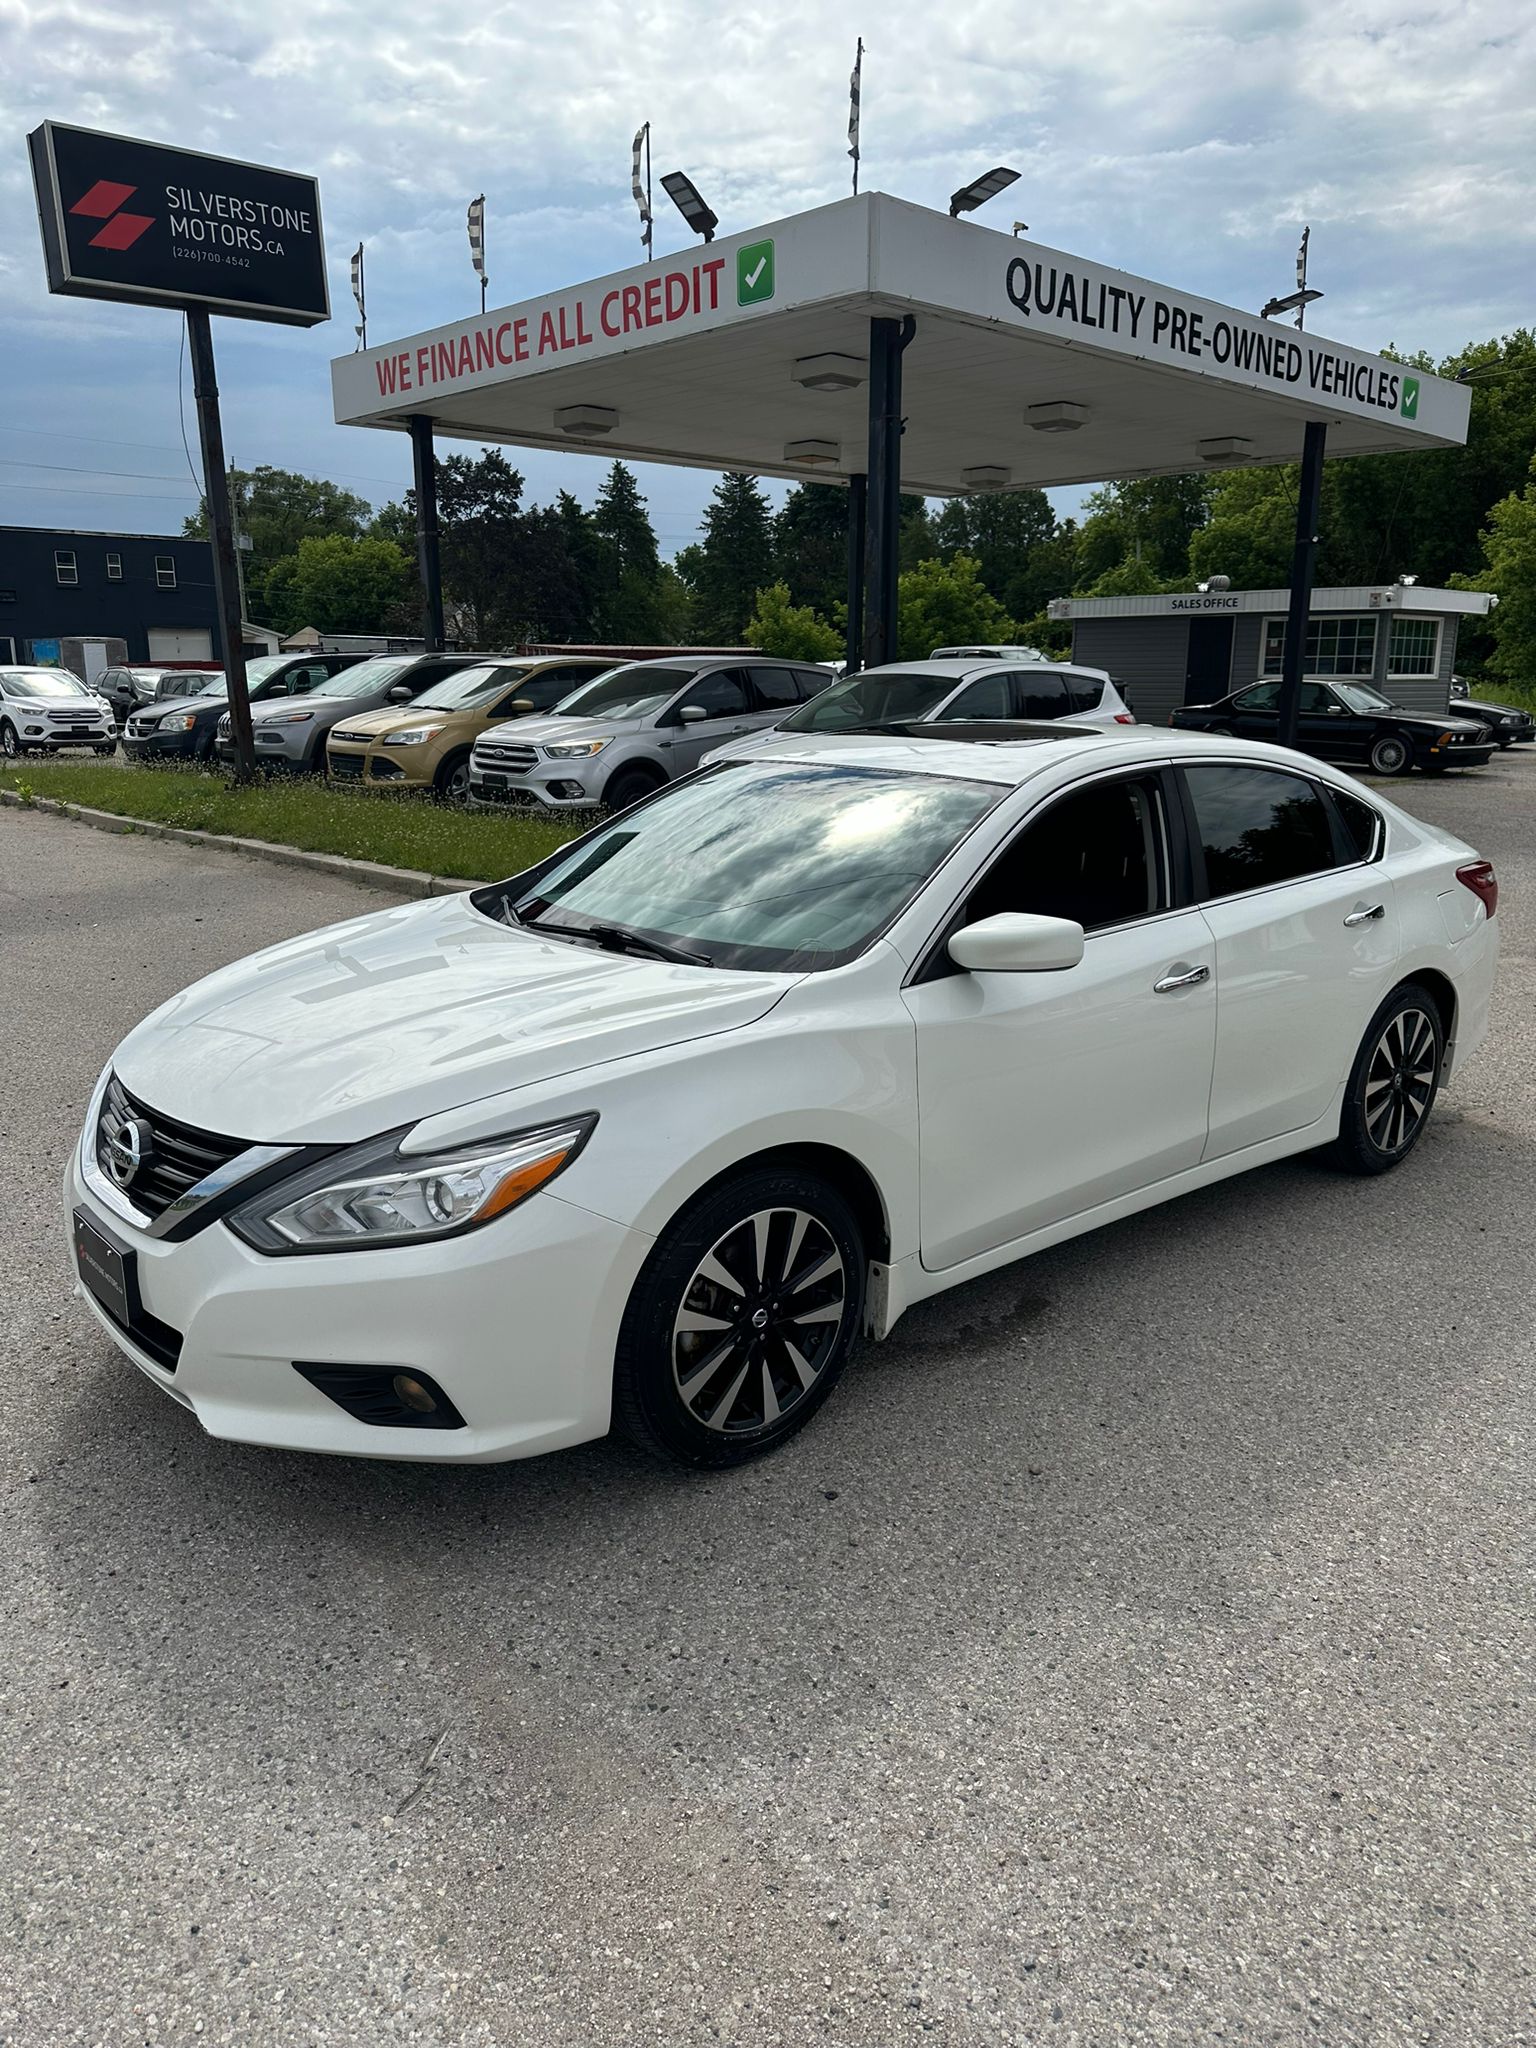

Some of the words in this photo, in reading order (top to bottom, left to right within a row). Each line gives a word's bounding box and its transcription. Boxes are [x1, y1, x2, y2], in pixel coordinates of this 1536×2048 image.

[166, 186, 312, 233] SILVERSTONE
[170, 214, 285, 256] MOTORS.CA
[172, 246, 251, 268] (226)700-4542
[375, 351, 412, 397] WE
[417, 318, 531, 387] FINANCE
[538, 301, 594, 356] ALL
[600, 258, 726, 338] CREDIT
[1005, 256, 1147, 339] QUALITY
[1152, 300, 1302, 383] PRE-OWNED
[1307, 349, 1400, 411] VEHICLES
[1171, 599, 1201, 610] SALES
[1203, 597, 1239, 609] OFFICE
